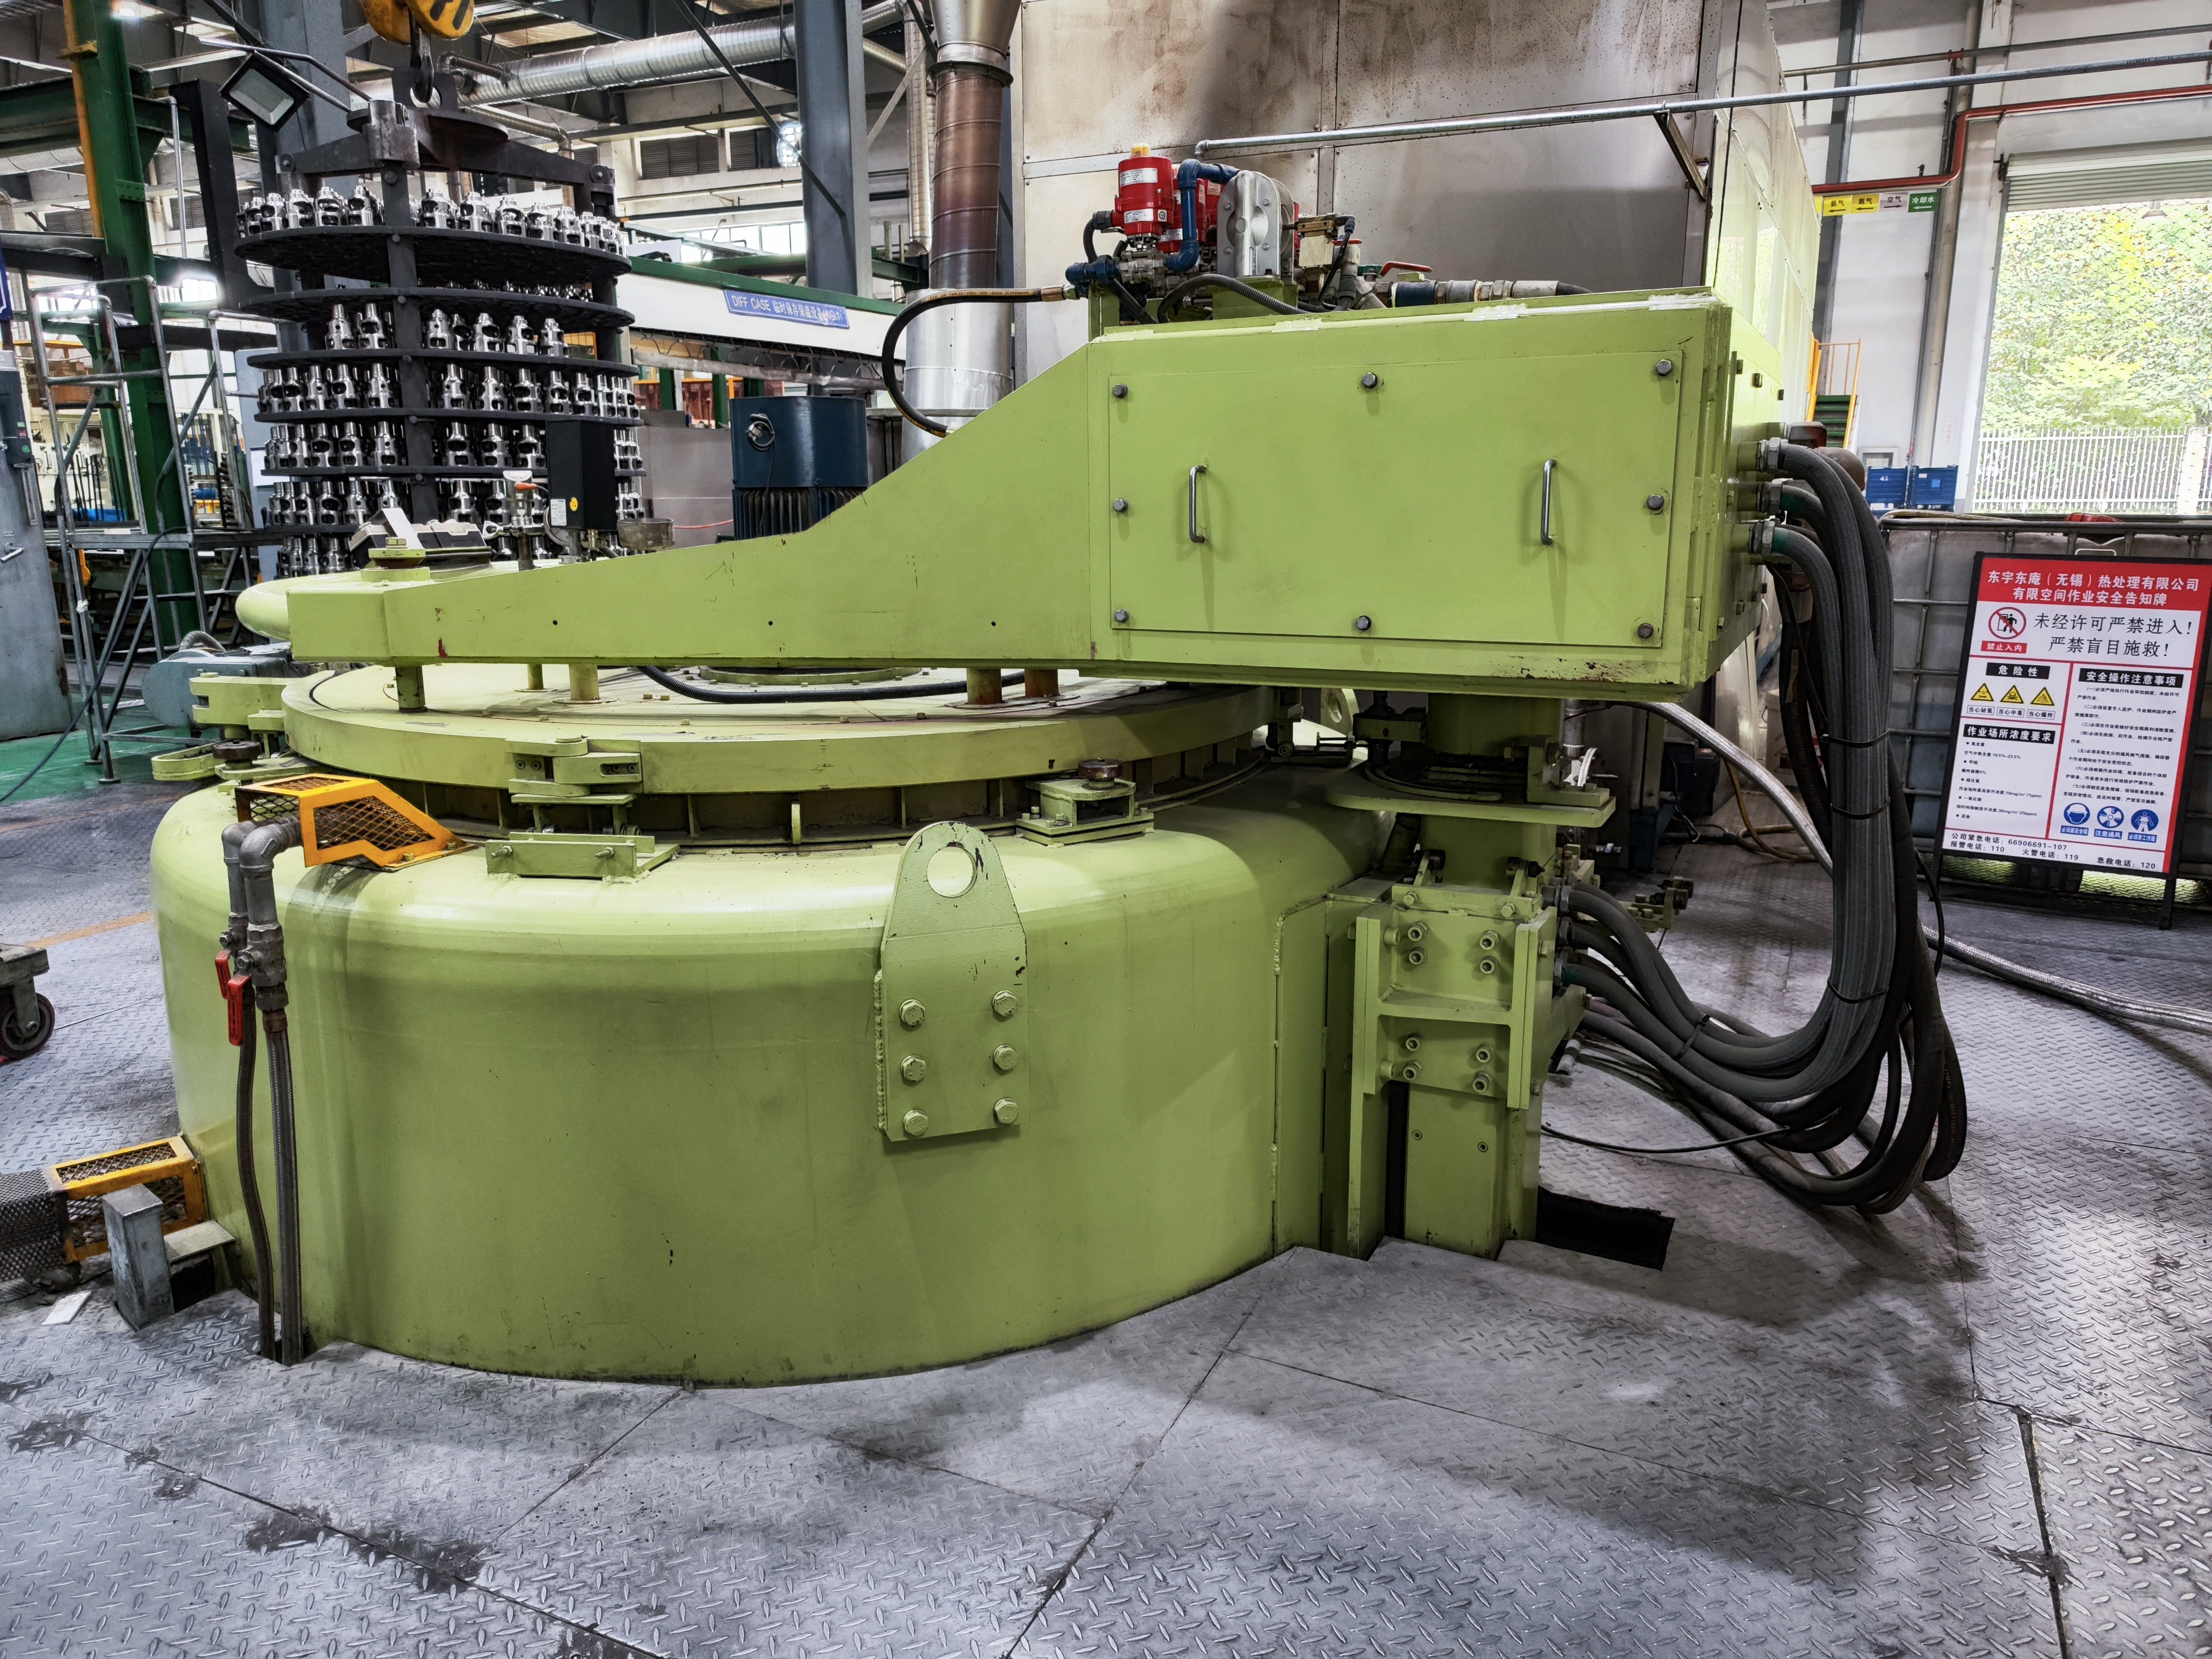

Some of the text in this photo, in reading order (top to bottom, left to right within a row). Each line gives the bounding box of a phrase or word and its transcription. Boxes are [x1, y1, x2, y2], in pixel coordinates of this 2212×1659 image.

[1911, 195, 1935, 204] 冷却水
[731, 294, 748, 308] DIFF
[751, 298, 772, 312] CASE
[1988, 570, 2199, 591] 东宇东庵（无锡）热处理有限公司
[2013, 587, 2167, 606] 有限空间作业安全告知牌
[2034, 613, 2191, 635] 未经许可严禁进入！
[1987, 643, 2022, 652] 禁止入内
[2048, 637, 2169, 657] 严禁盲目施救！
[1998, 665, 2038, 677] 危险性
[2087, 671, 2176, 686] 安全操作注意事项
[1967, 726, 2051, 742] 作业场所浓度要求
[2095, 830, 2121, 838] 注意通风
